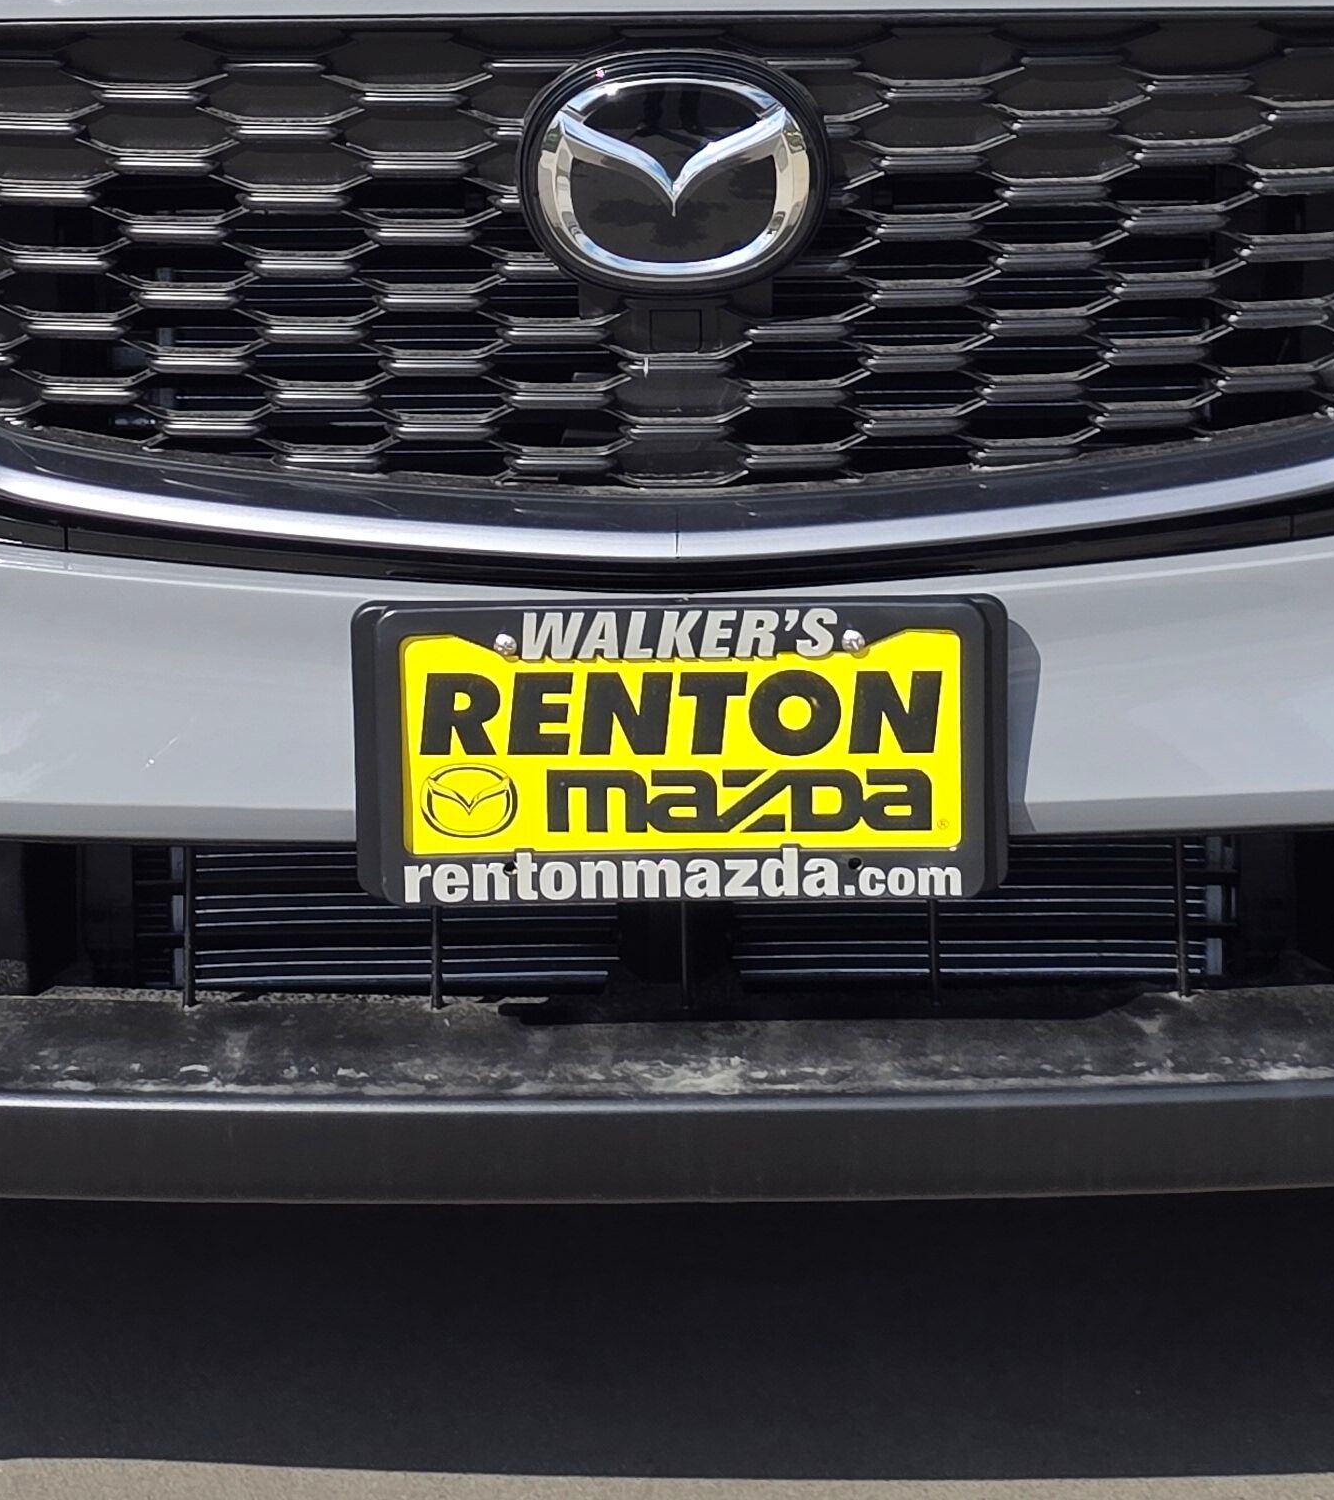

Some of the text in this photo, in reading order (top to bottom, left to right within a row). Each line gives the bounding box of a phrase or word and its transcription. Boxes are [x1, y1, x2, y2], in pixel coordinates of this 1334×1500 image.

[521, 607, 838, 662] WALKER'S
[419, 669, 943, 757] RENTON
[402, 847, 963, 903] rentonmazda.com
